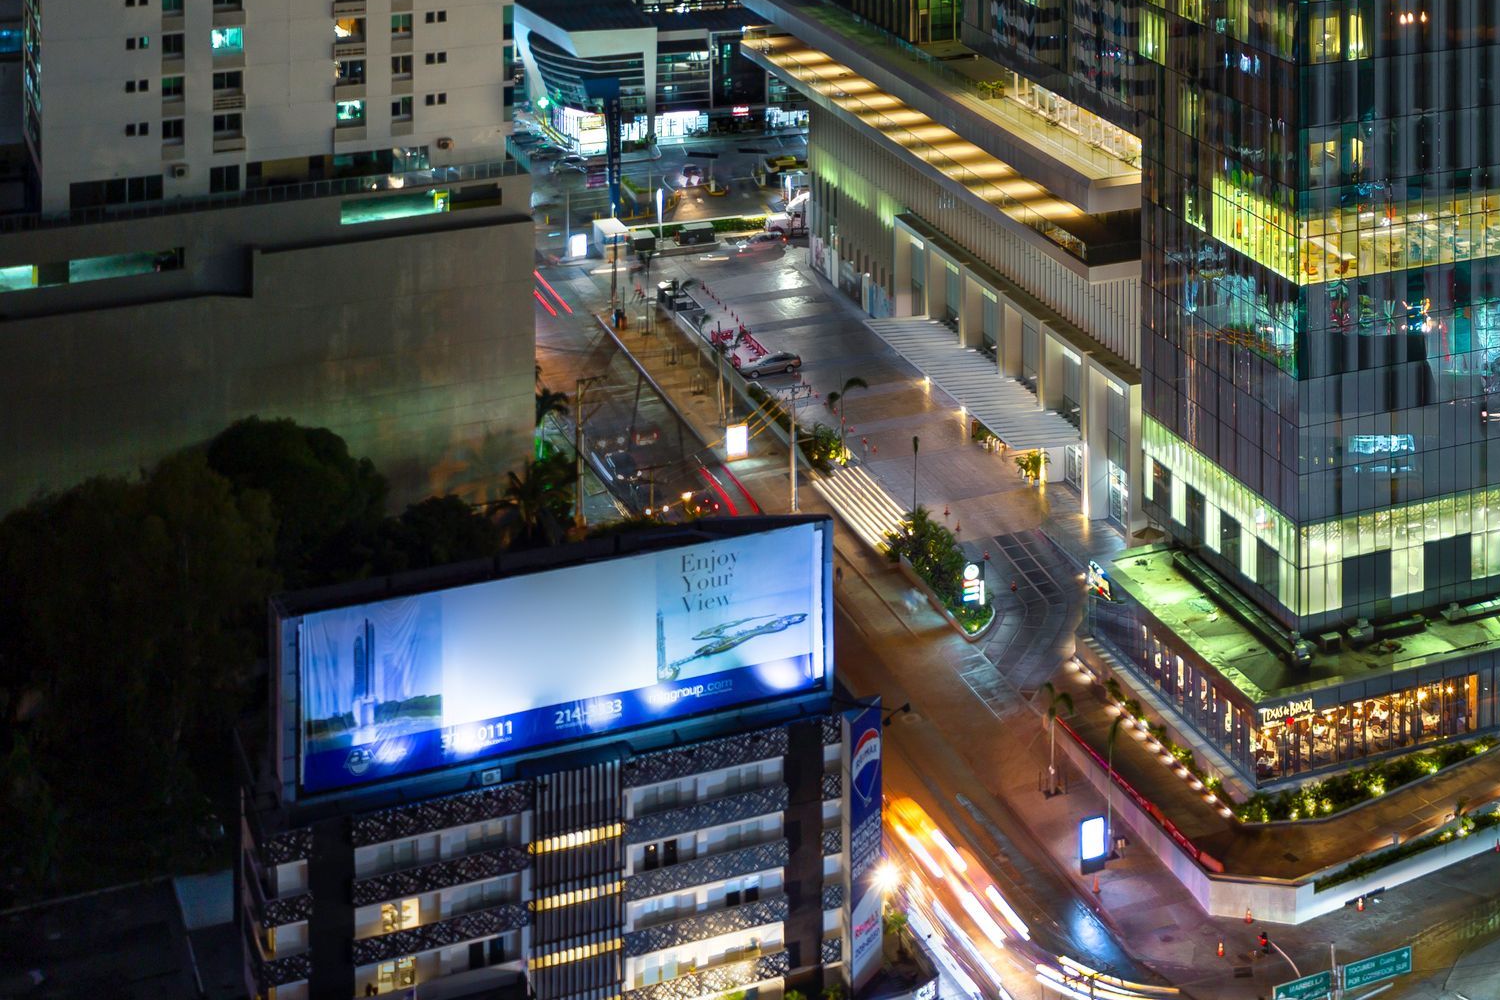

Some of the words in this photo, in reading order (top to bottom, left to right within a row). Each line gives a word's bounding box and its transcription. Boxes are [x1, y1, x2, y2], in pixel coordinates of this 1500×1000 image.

[681, 549, 740, 575] Enjoy
[681, 573, 733, 593] Your
[681, 593, 732, 613] View
[1258, 705, 1284, 726] TEXAS
[1288, 697, 1315, 717] BRAZIL
